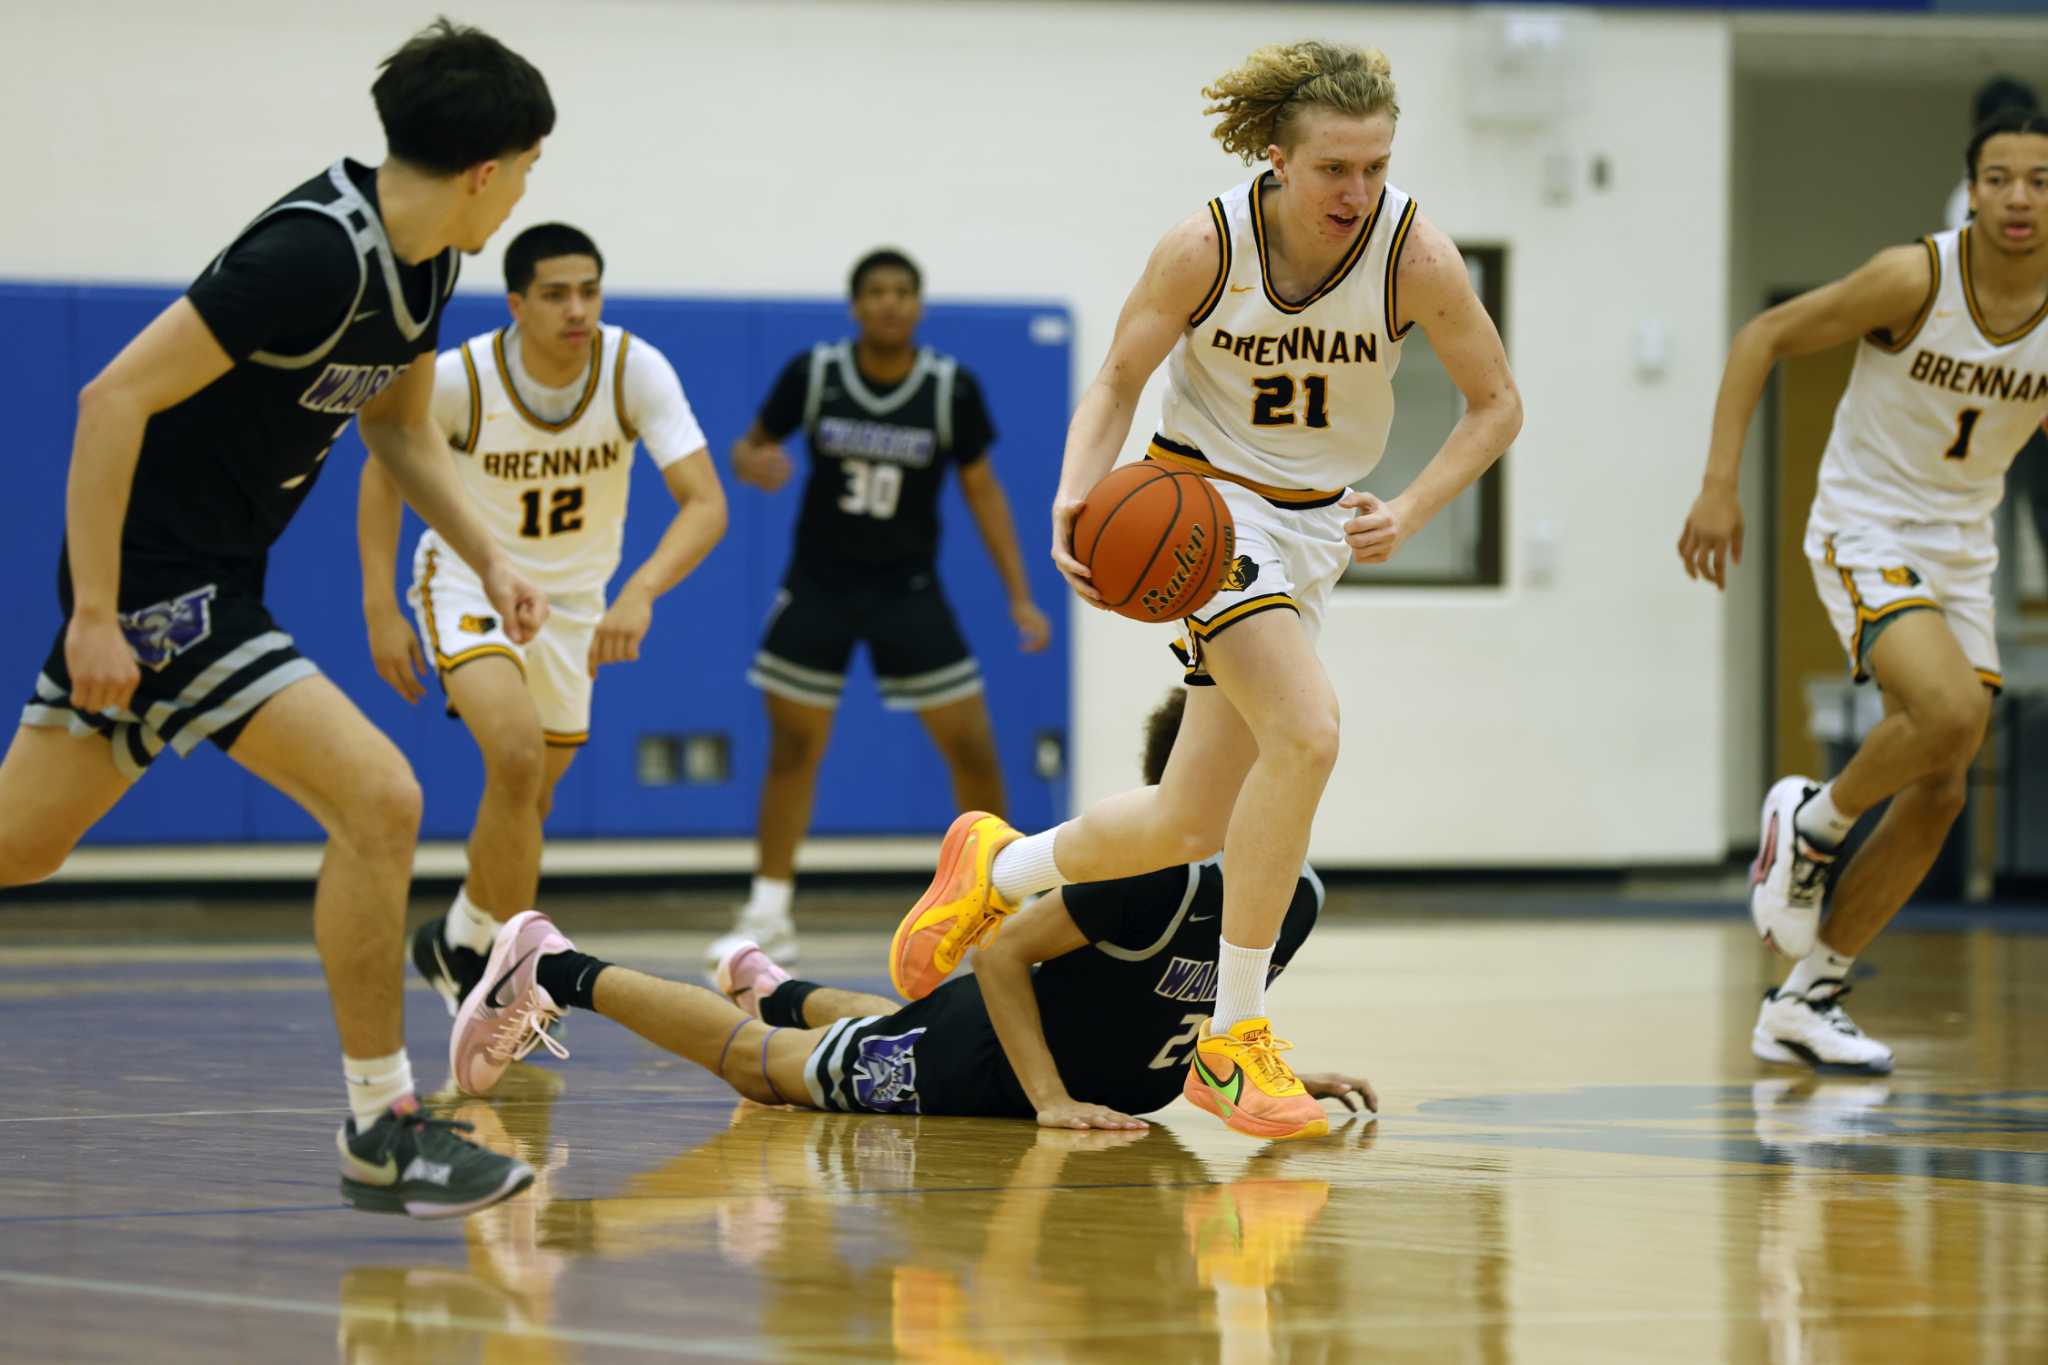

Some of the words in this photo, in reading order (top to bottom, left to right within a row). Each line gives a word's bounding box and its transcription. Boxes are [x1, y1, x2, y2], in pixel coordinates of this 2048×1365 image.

[1210, 326, 1378, 367] BRENNAN
[1250, 373, 1331, 430] 21
[484, 441, 619, 480] BRENNAN
[1943, 405, 1983, 461] 1
[519, 484, 586, 538] 12
[837, 457, 903, 520] 30
[1141, 523, 1206, 616] Baden
